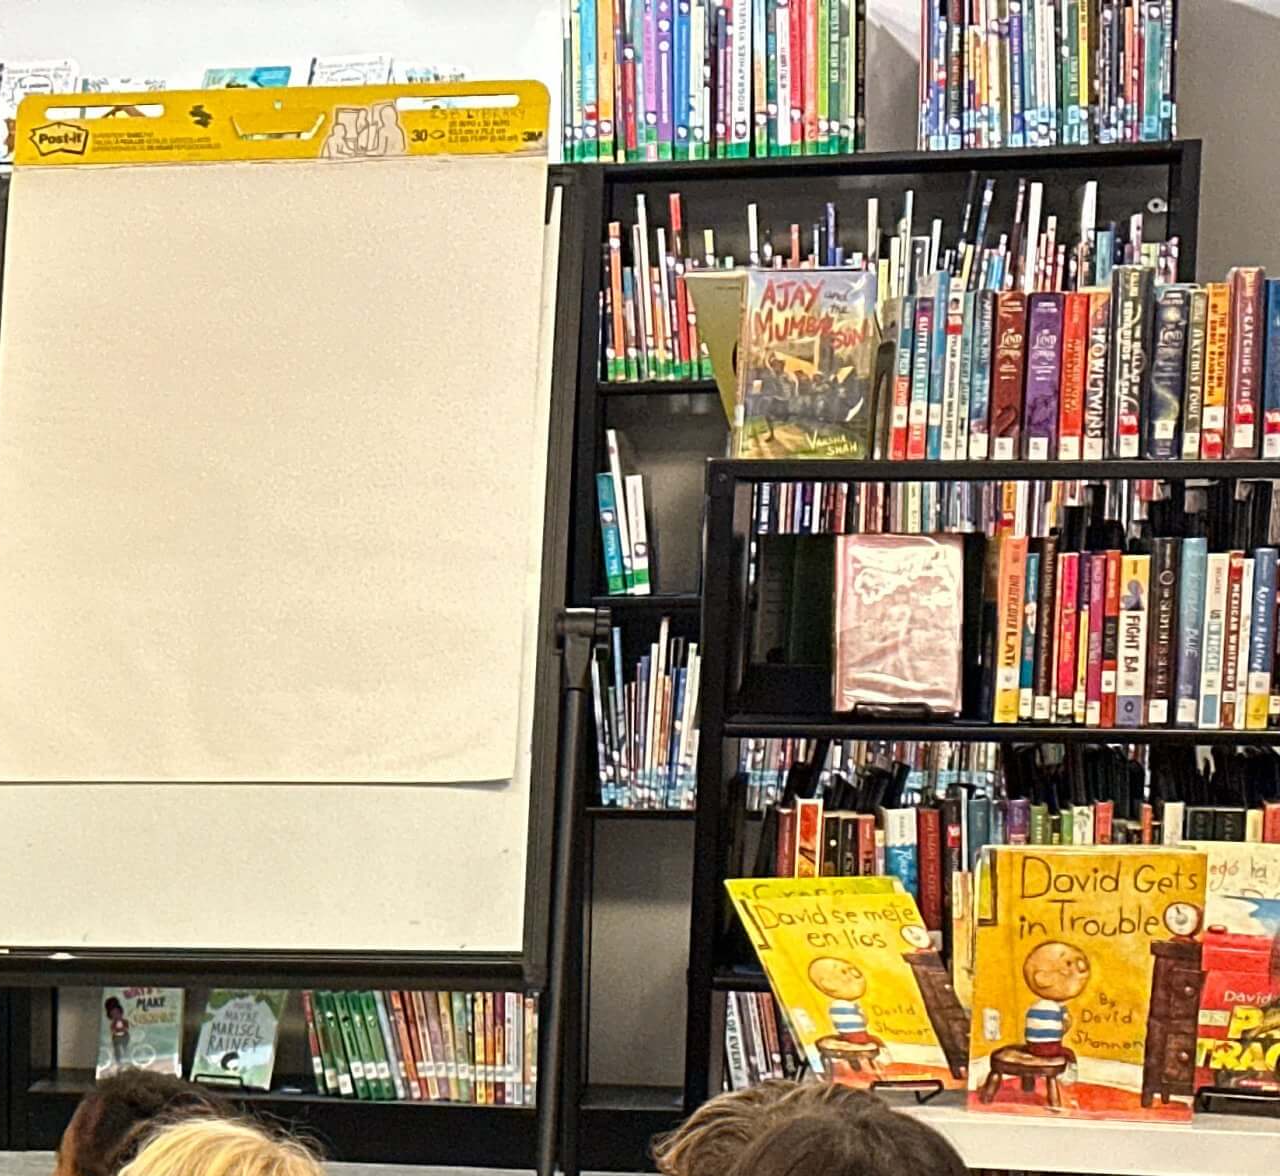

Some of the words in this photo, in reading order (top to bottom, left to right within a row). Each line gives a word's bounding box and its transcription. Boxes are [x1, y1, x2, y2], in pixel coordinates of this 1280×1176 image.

[39, 133, 82, 145] Post-it
[410, 130, 428, 142] 30
[522, 131, 542, 142] 3M
[760, 279, 825, 311] AJAY
[831, 318, 873, 348] SUN
[918, 316, 929, 353] GLITTER
[1242, 316, 1253, 374] CATCHING
[916, 357, 928, 379] GETS
[1132, 341, 1142, 383] BALLAD
[1191, 329, 1203, 382] ARTEMIS
[1216, 334, 1227, 388] REVOLUTION
[948, 360, 956, 399] JOHNSON
[1206, 351, 1217, 397] RANDOLPH
[1120, 377, 1131, 415] SNAKE
[1188, 386, 1201, 420] FOWL
[826, 443, 857, 456] SHAH
[1006, 575, 1019, 629] UNDERCOVER
[1230, 583, 1241, 630] MEXICAN
[1125, 615, 1140, 652] FIGHT
[1123, 656, 1140, 673] BA
[1226, 634, 1238, 688] WHITEBOY
[1020, 856, 1121, 899] David
[1133, 864, 1199, 894] Gets
[1209, 858, 1238, 892] egó
[753, 903, 827, 930] David
[831, 911, 857, 925] se
[864, 901, 914, 924] mete
[1019, 915, 1048, 940] in
[1047, 899, 1159, 937] Trouble
[807, 930, 838, 948] en
[843, 929, 887, 949] líos
[1098, 993, 1116, 1009] By
[1223, 990, 1273, 1004] David
[1081, 1008, 1133, 1024] David
[207, 1037, 264, 1051] RAINEY
[730, 1036, 741, 1071] EVERY
[1071, 1030, 1144, 1050] Shannon
[1197, 1040, 1280, 1072] TRAC
